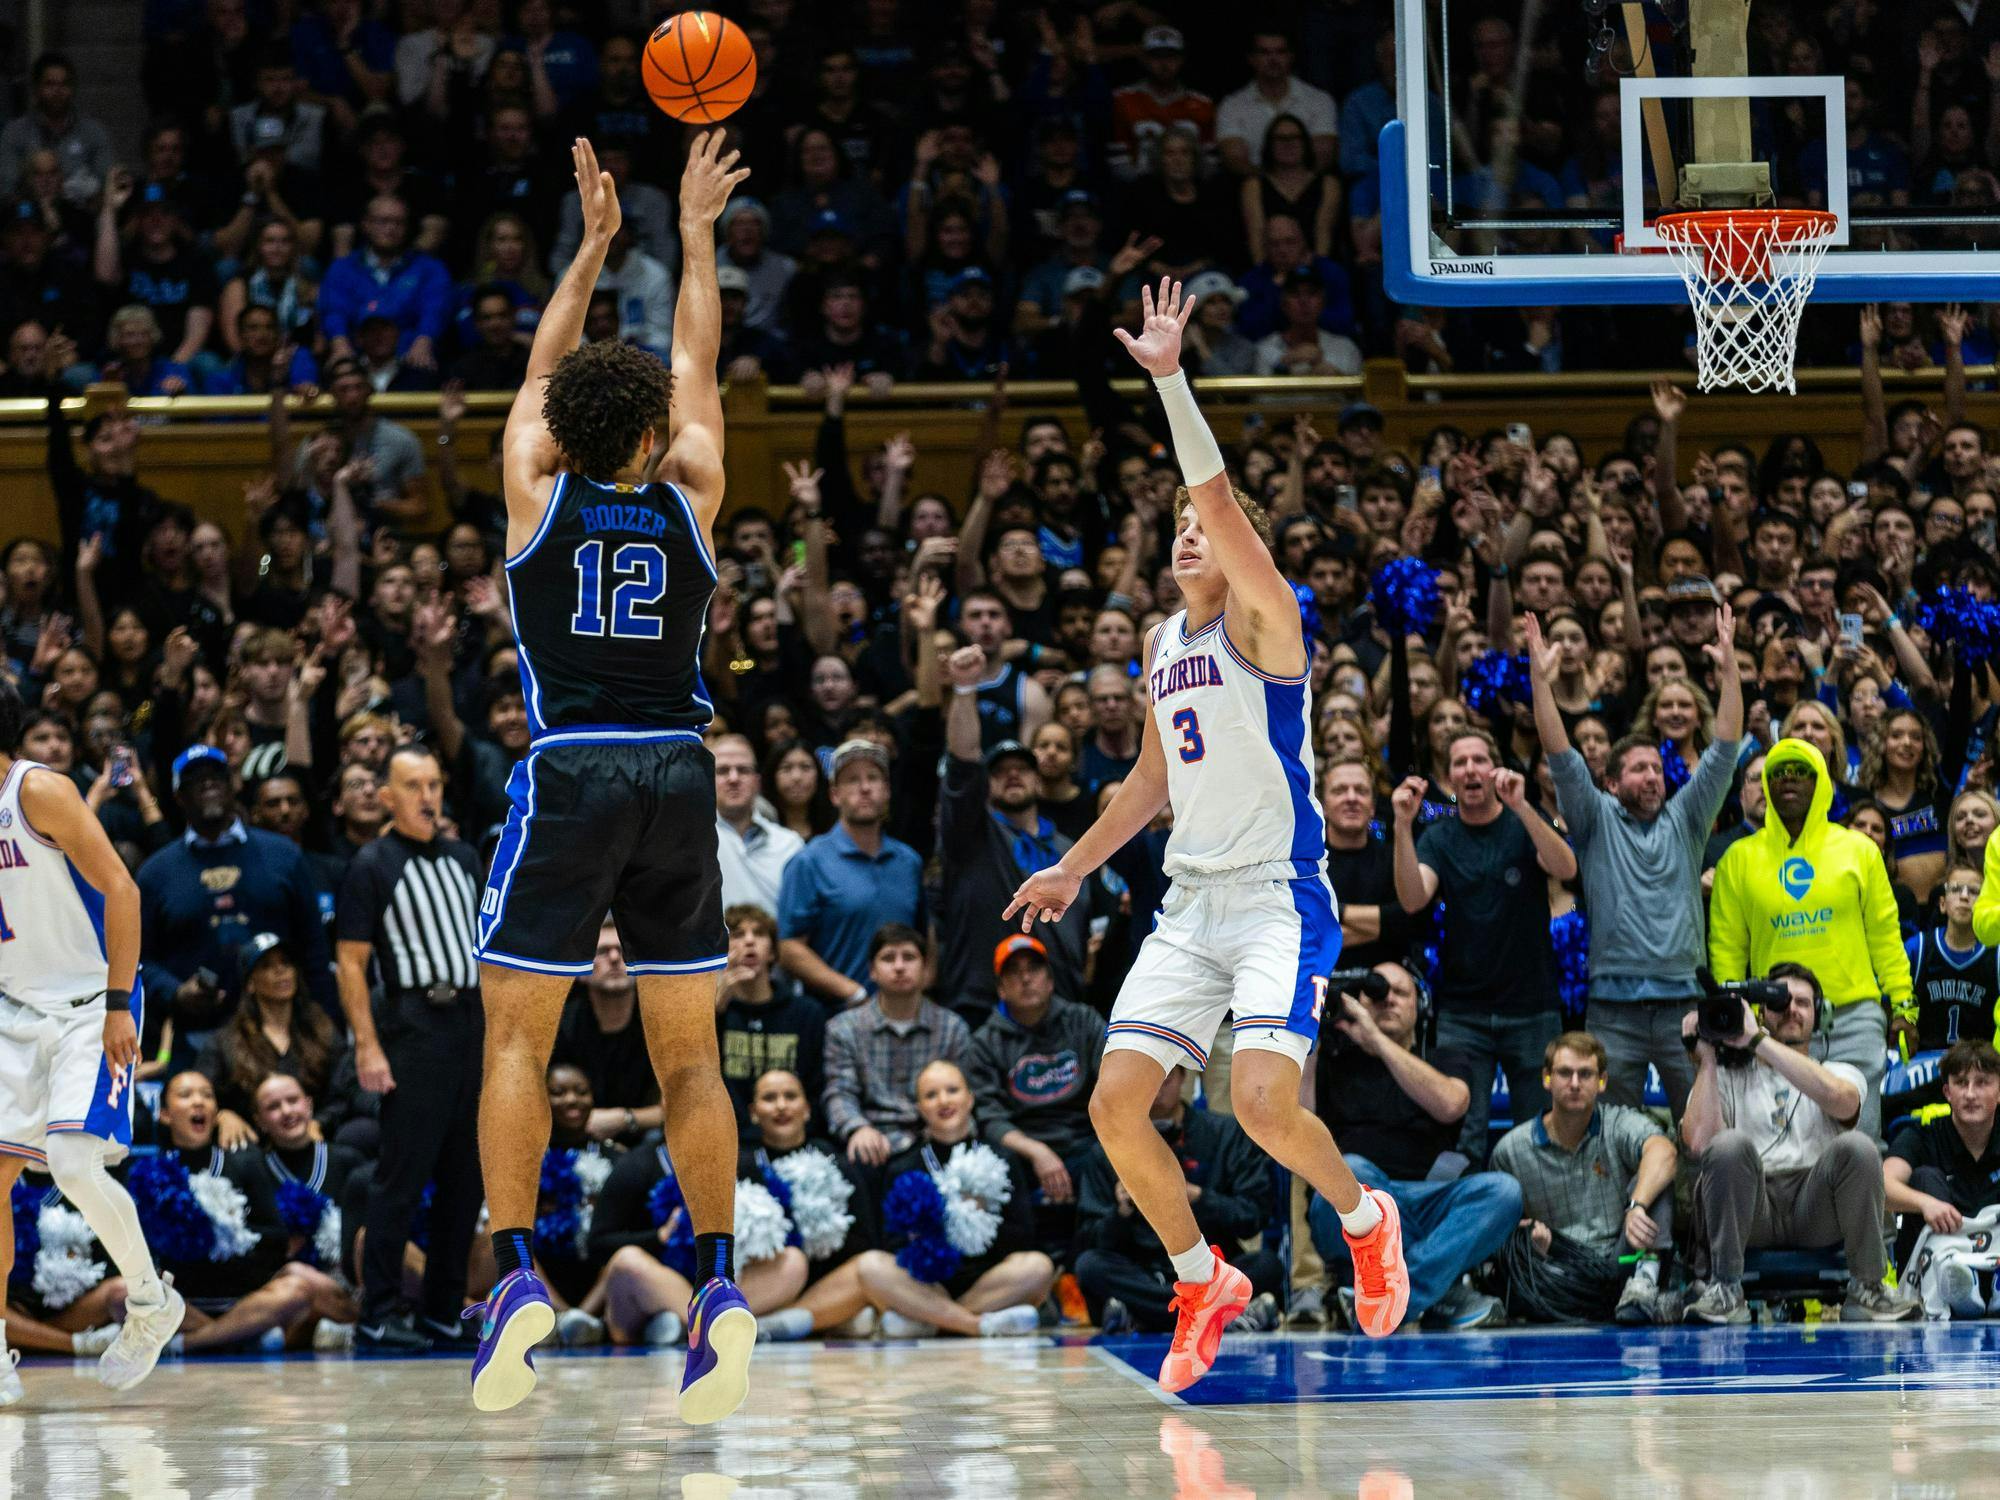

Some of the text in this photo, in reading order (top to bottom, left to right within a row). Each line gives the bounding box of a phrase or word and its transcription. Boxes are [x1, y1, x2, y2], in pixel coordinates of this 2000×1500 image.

[1430, 261, 1494, 276] SPALDING
[580, 504, 667, 538] BOOZER
[571, 540, 667, 640] 12
[1151, 654, 1224, 707] FLORIDA
[1172, 707, 1206, 764] 3
[0, 838, 29, 869] DA
[482, 886, 499, 915] D
[1770, 907, 1833, 930] wave
[1926, 978, 1986, 1008] DUKE
[1947, 1004, 1960, 1045] 1
